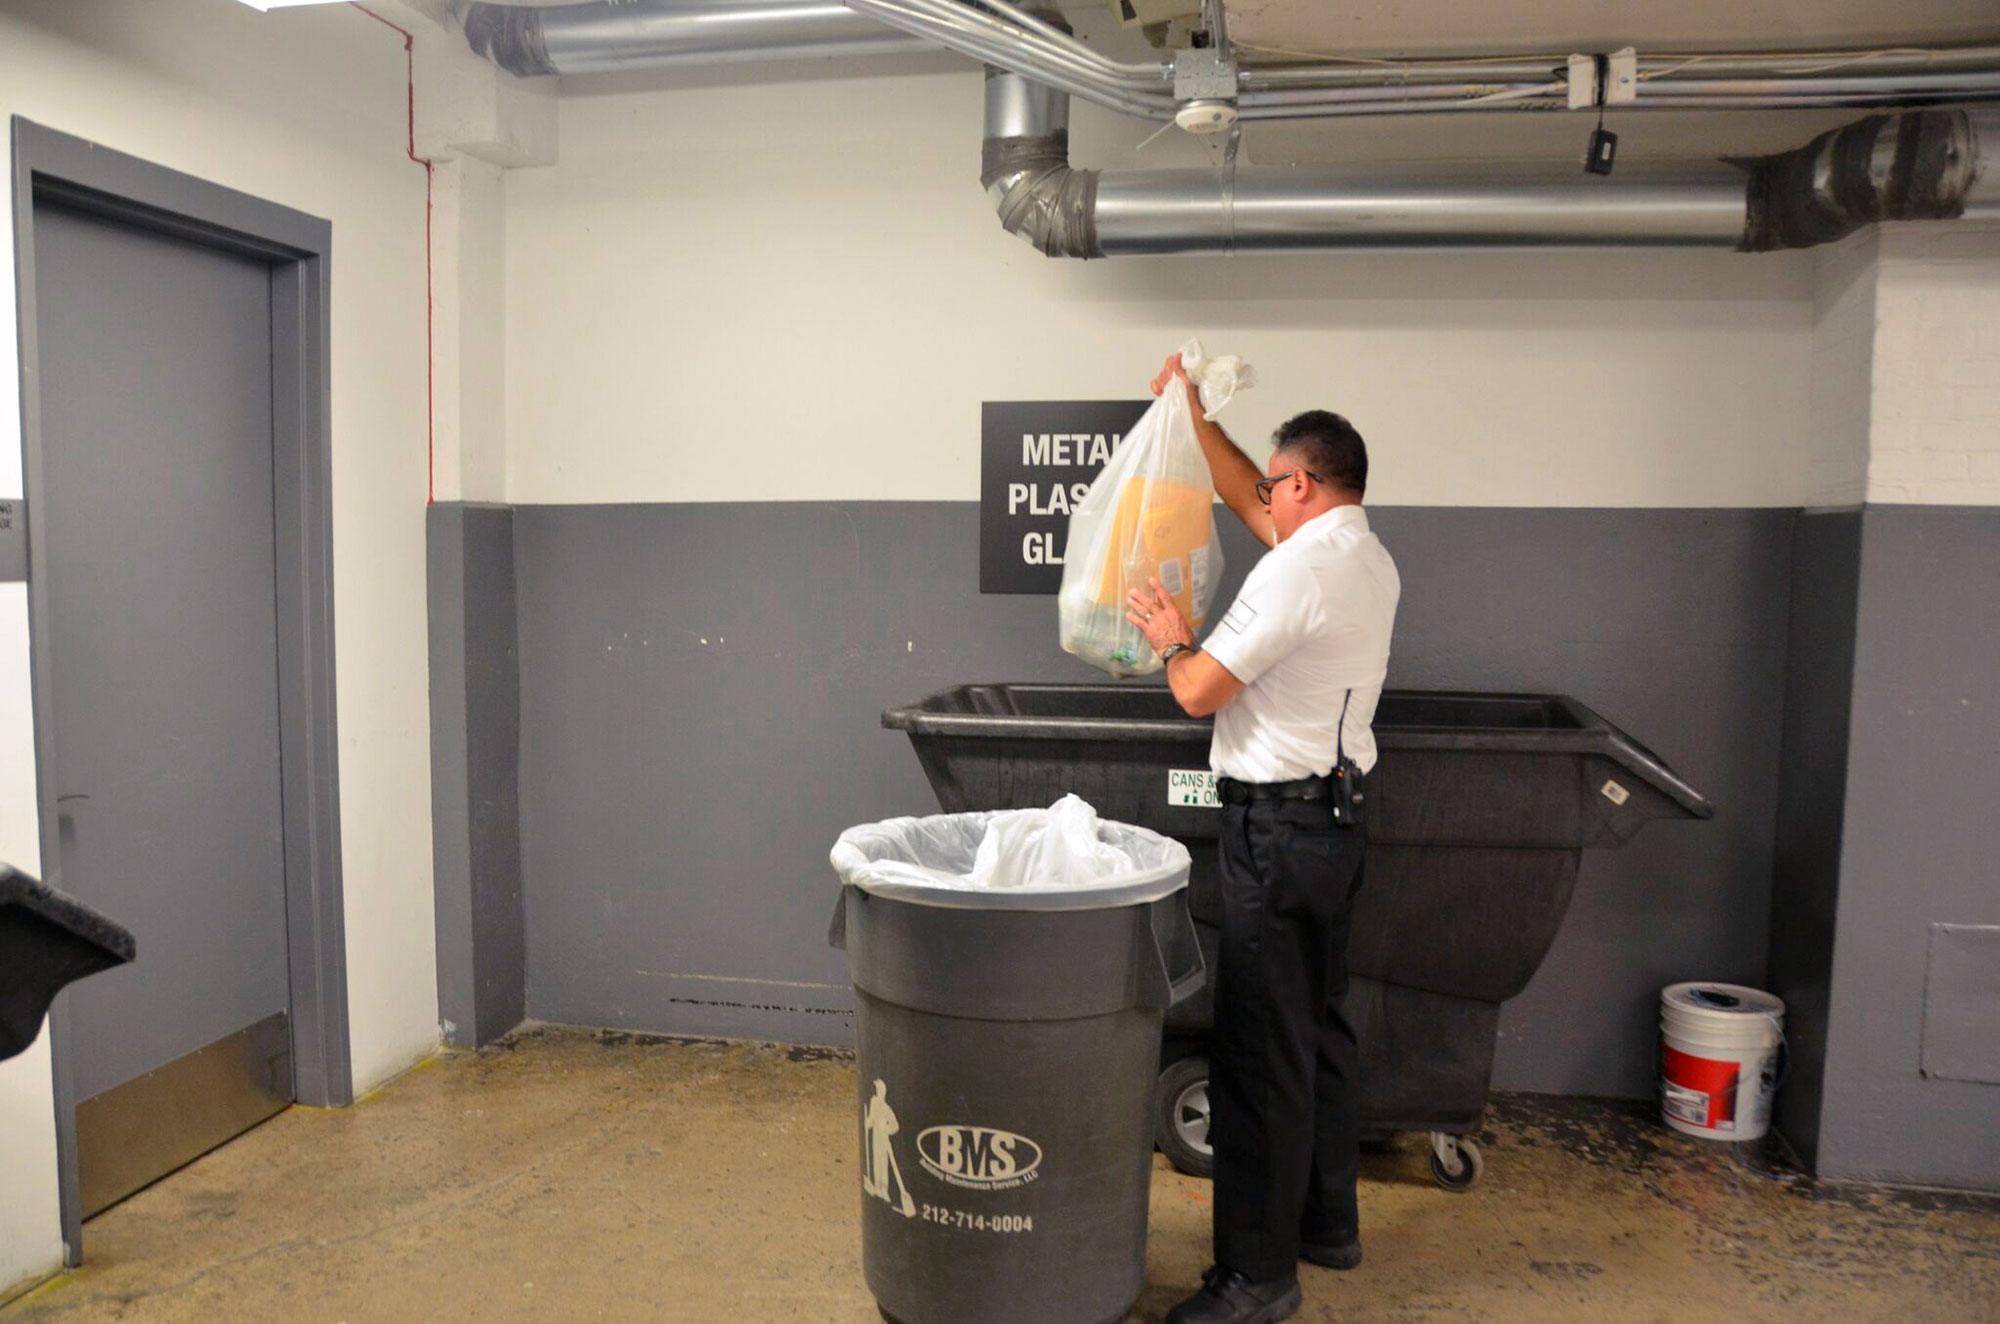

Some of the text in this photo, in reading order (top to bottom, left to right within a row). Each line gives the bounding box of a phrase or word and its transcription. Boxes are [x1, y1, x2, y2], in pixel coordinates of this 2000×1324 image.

[1022, 532, 1066, 565] GL
[1171, 772, 1215, 788] CANS &
[939, 1128, 1016, 1180] BMS
[1023, 1169, 1039, 1183] LLC
[922, 1203, 1033, 1232] 212-714-0004
